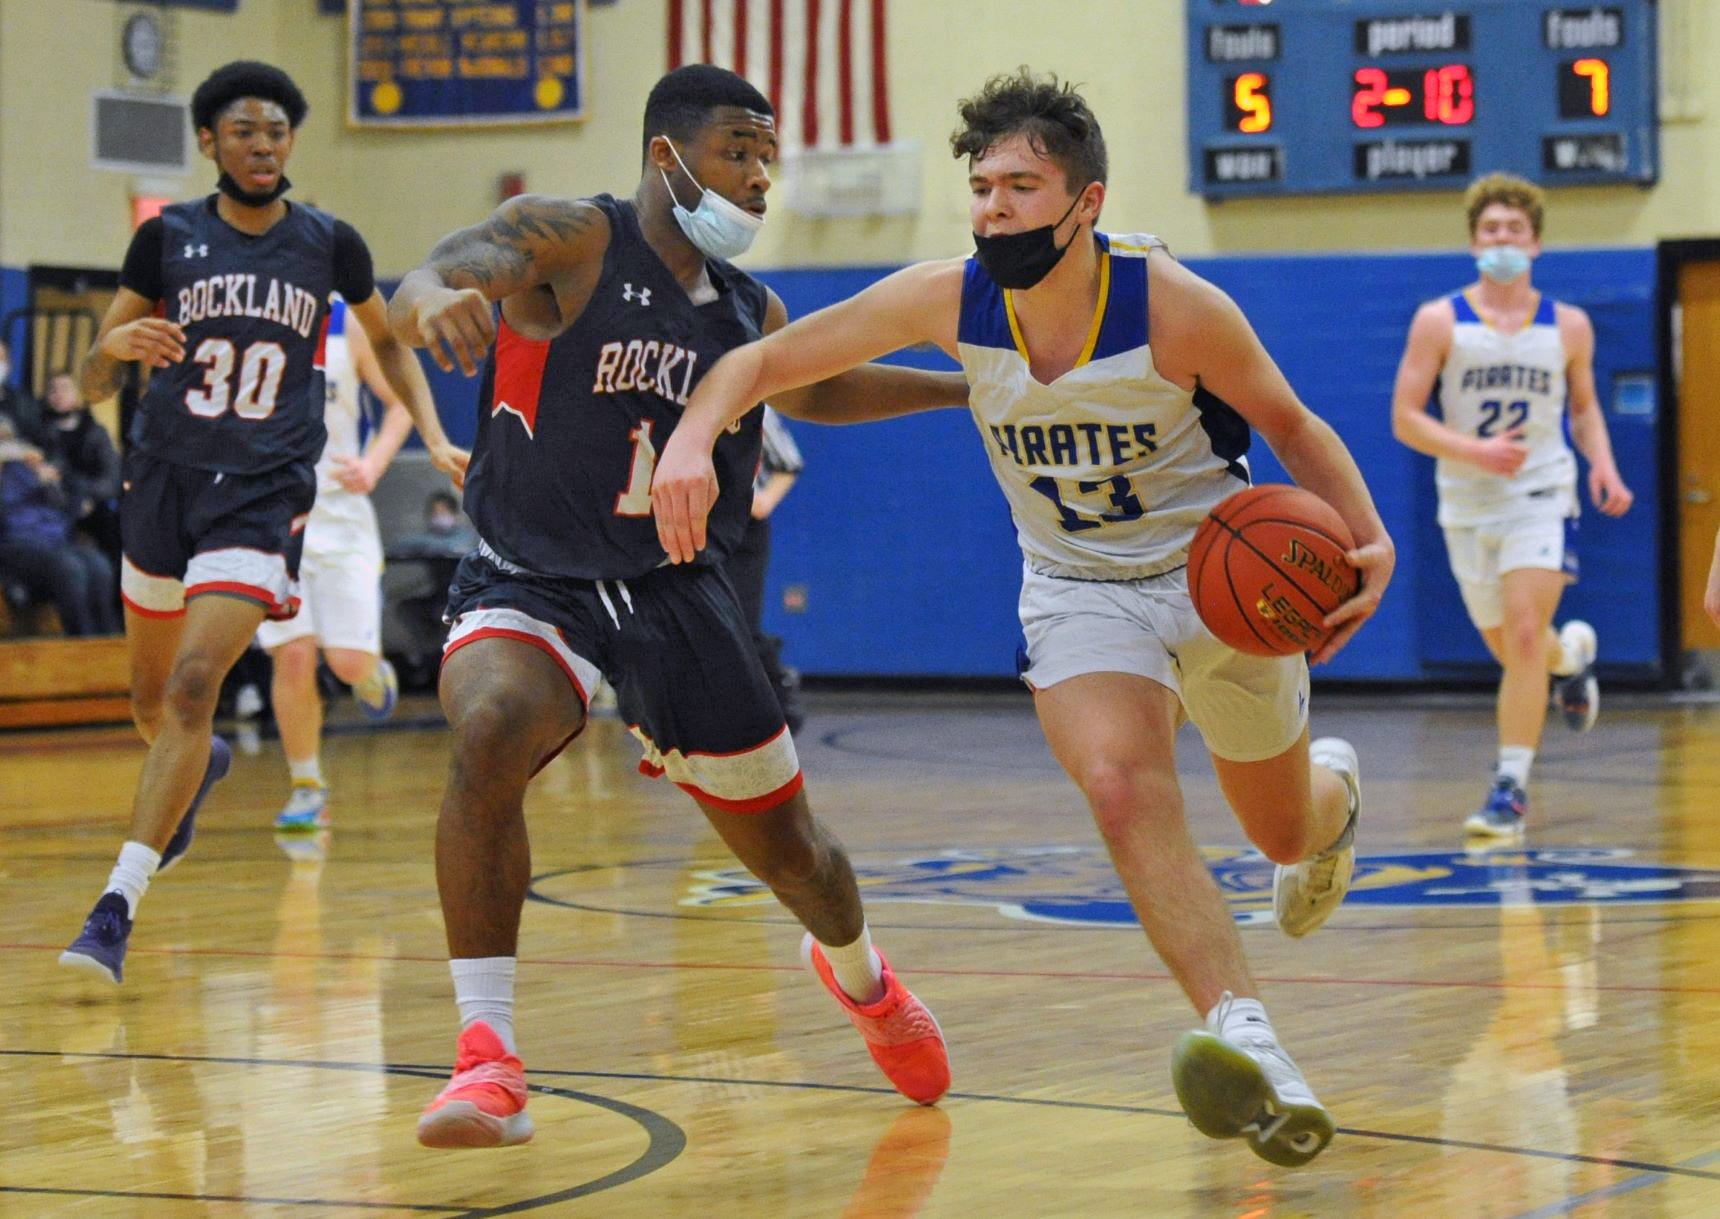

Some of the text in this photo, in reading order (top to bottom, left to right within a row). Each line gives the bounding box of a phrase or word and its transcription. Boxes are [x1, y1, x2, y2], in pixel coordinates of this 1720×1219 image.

[1368, 14, 1456, 57] period
[1234, 71, 1272, 133] 5
[1573, 58, 1610, 117] 7
[177, 273, 317, 338] ROCKLAND
[184, 337, 288, 420] 30
[591, 339, 706, 409] ROCKL
[1461, 365, 1551, 395] PIRATES
[1476, 399, 1530, 440] 22
[1028, 474, 1146, 533] 13
